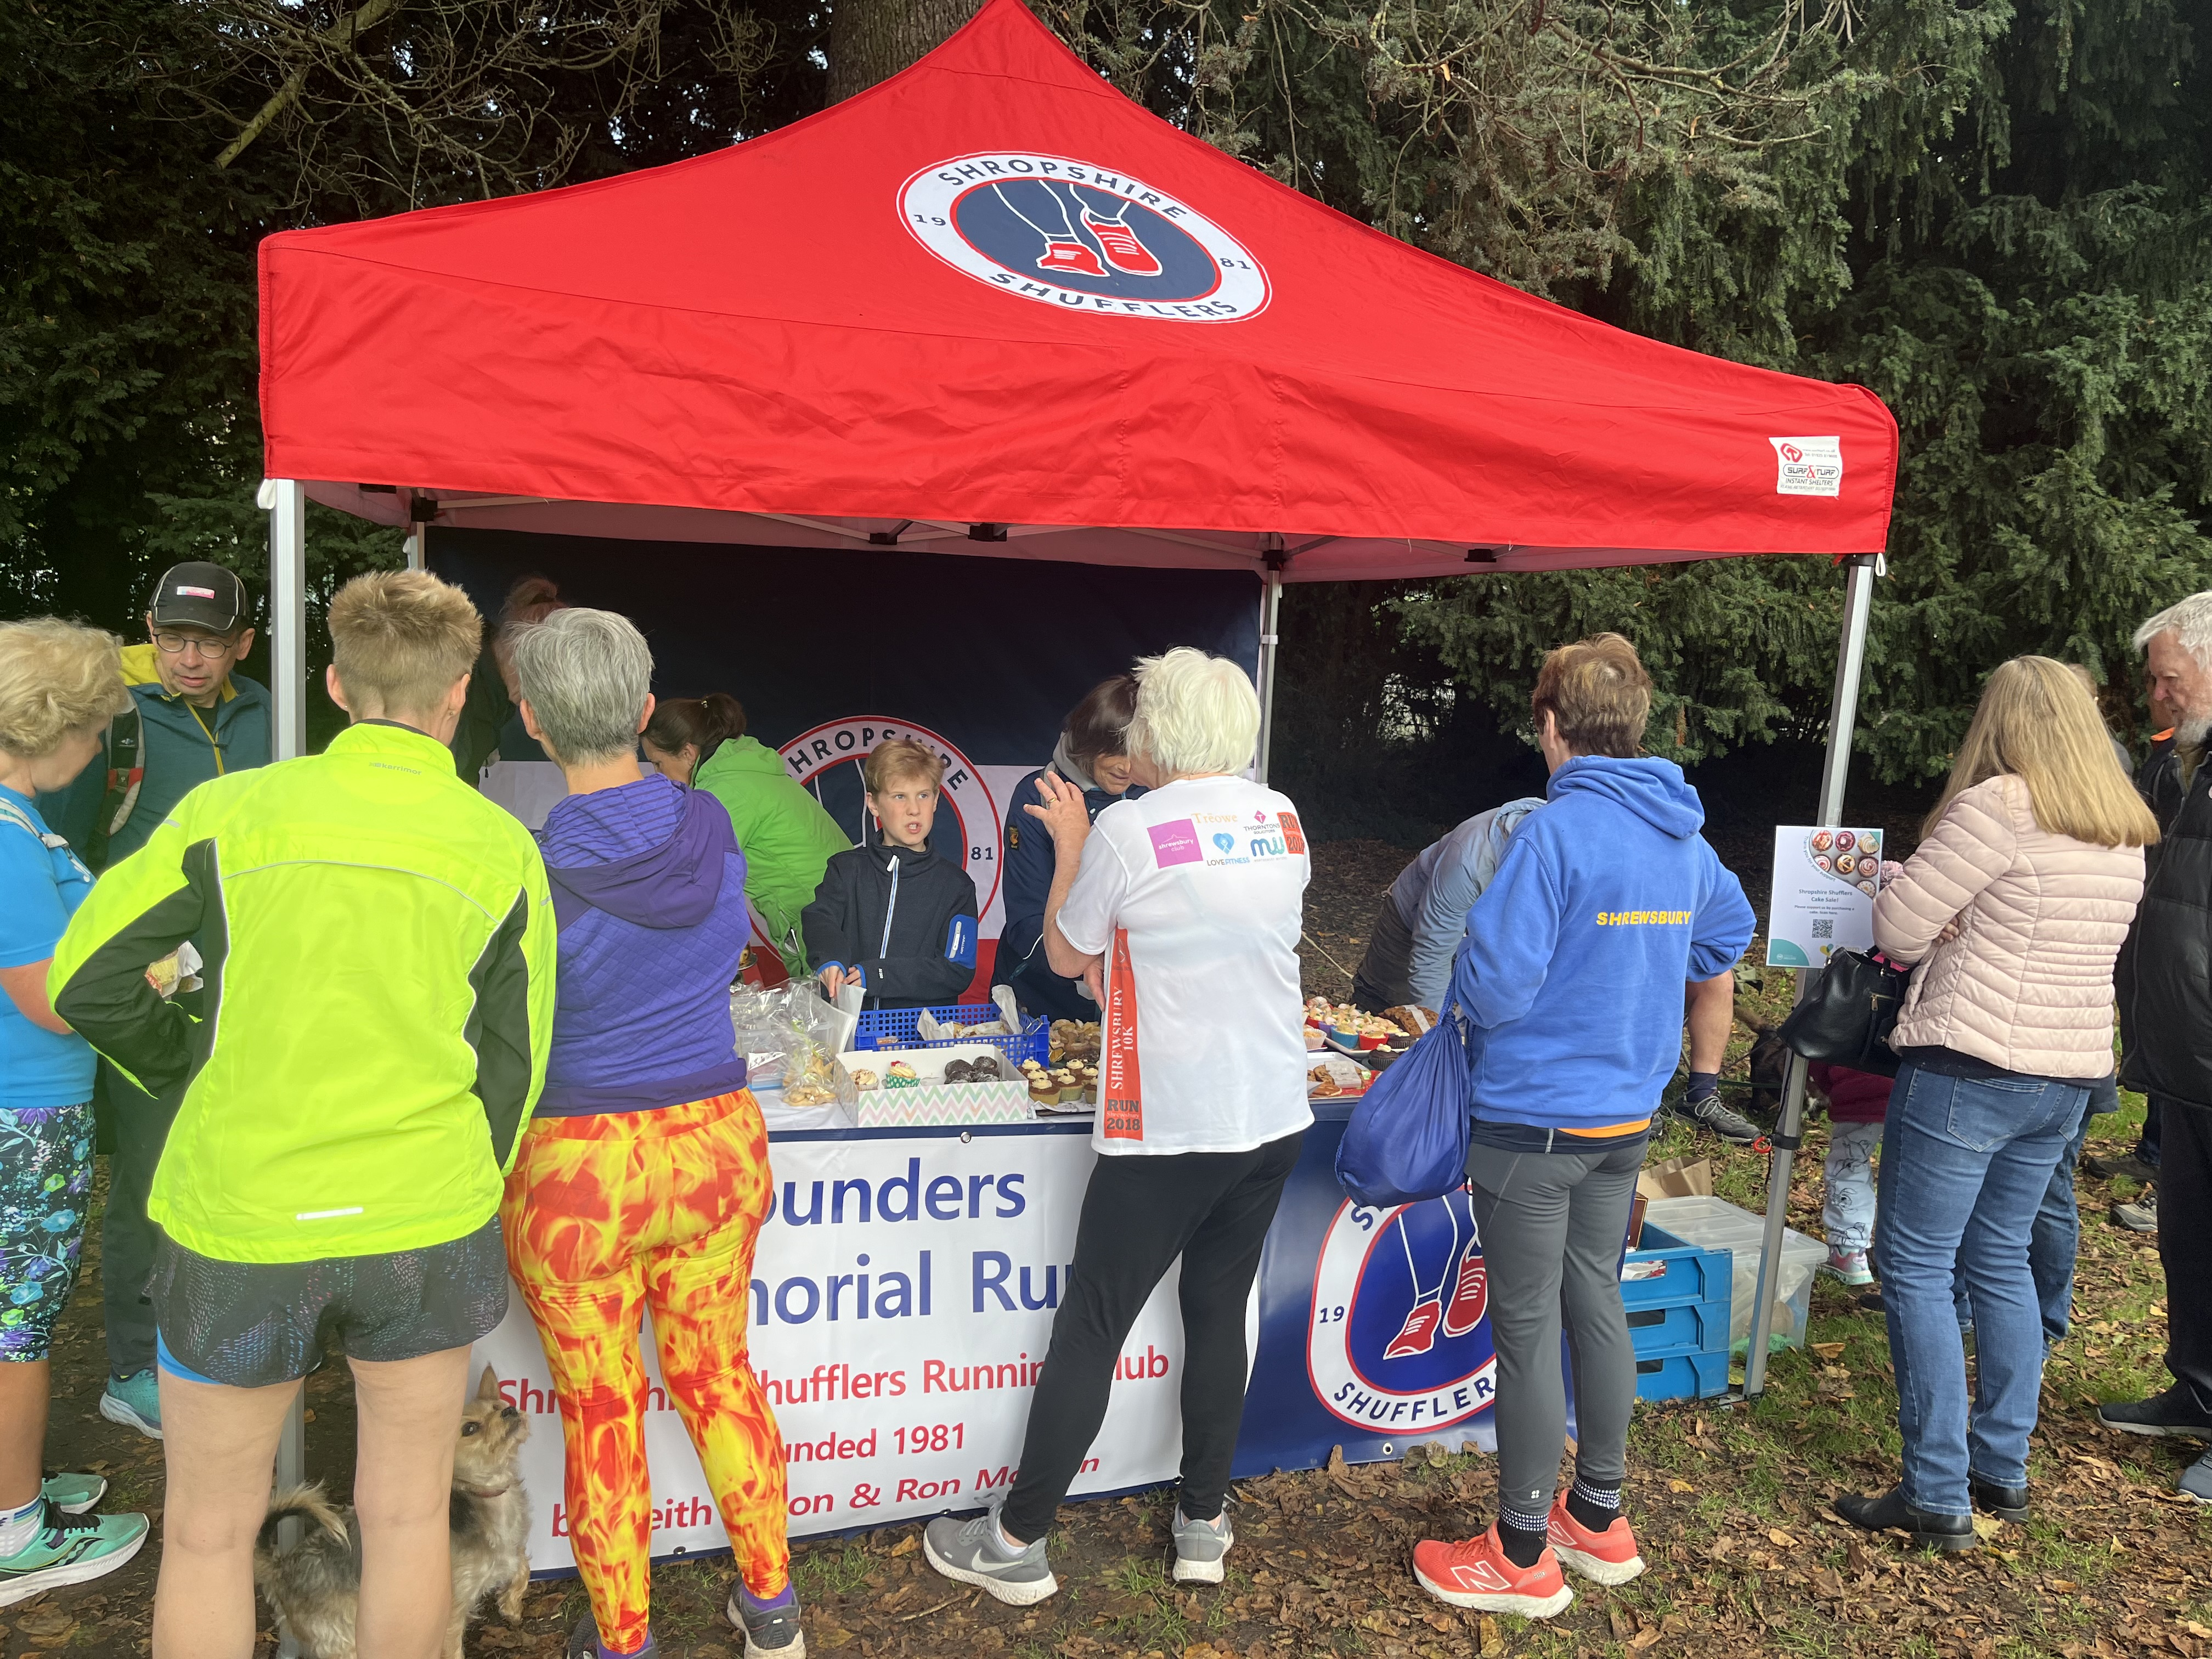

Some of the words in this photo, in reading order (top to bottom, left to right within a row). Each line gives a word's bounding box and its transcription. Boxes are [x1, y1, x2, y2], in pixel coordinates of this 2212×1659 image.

[939, 159, 1187, 218] SHROPSHIRE
[913, 214, 946, 227] 19
[1220, 257, 1251, 270] 81
[990, 273, 1238, 317] SHUFFLERS
[381, 763, 422, 775] karrimor
[787, 727, 968, 791] HROPSRE
[1244, 823, 1280, 832] THORNTONS
[971, 847, 994, 860] 81
[1158, 839, 1194, 850] shrewsbury
[1811, 864, 1821, 873] your
[1820, 871, 1836, 882] support
[1596, 910, 1691, 926] SHREWSBURY
[1110, 986, 1123, 1091] SHREWSBURY
[1122, 1025, 1133, 1051] 10K
[1107, 1099, 1139, 1113] RUN
[1107, 1118, 1141, 1131] 2018
[761, 1157, 1025, 1226] unders
[749, 1250, 931, 1327] orial
[1319, 1306, 1345, 1323] 19
[752, 1363, 906, 1406] hufflers
[923, 1352, 1045, 1393] Runnin
[1113, 1345, 1169, 1380] lub
[1334, 1375, 1496, 1422] SHUFFLER
[785, 1427, 877, 1463] nded
[893, 1423, 964, 1455] 1981
[651, 1496, 712, 1531] eith
[849, 1483, 881, 1509] &
[895, 1479, 960, 1503] Ron
